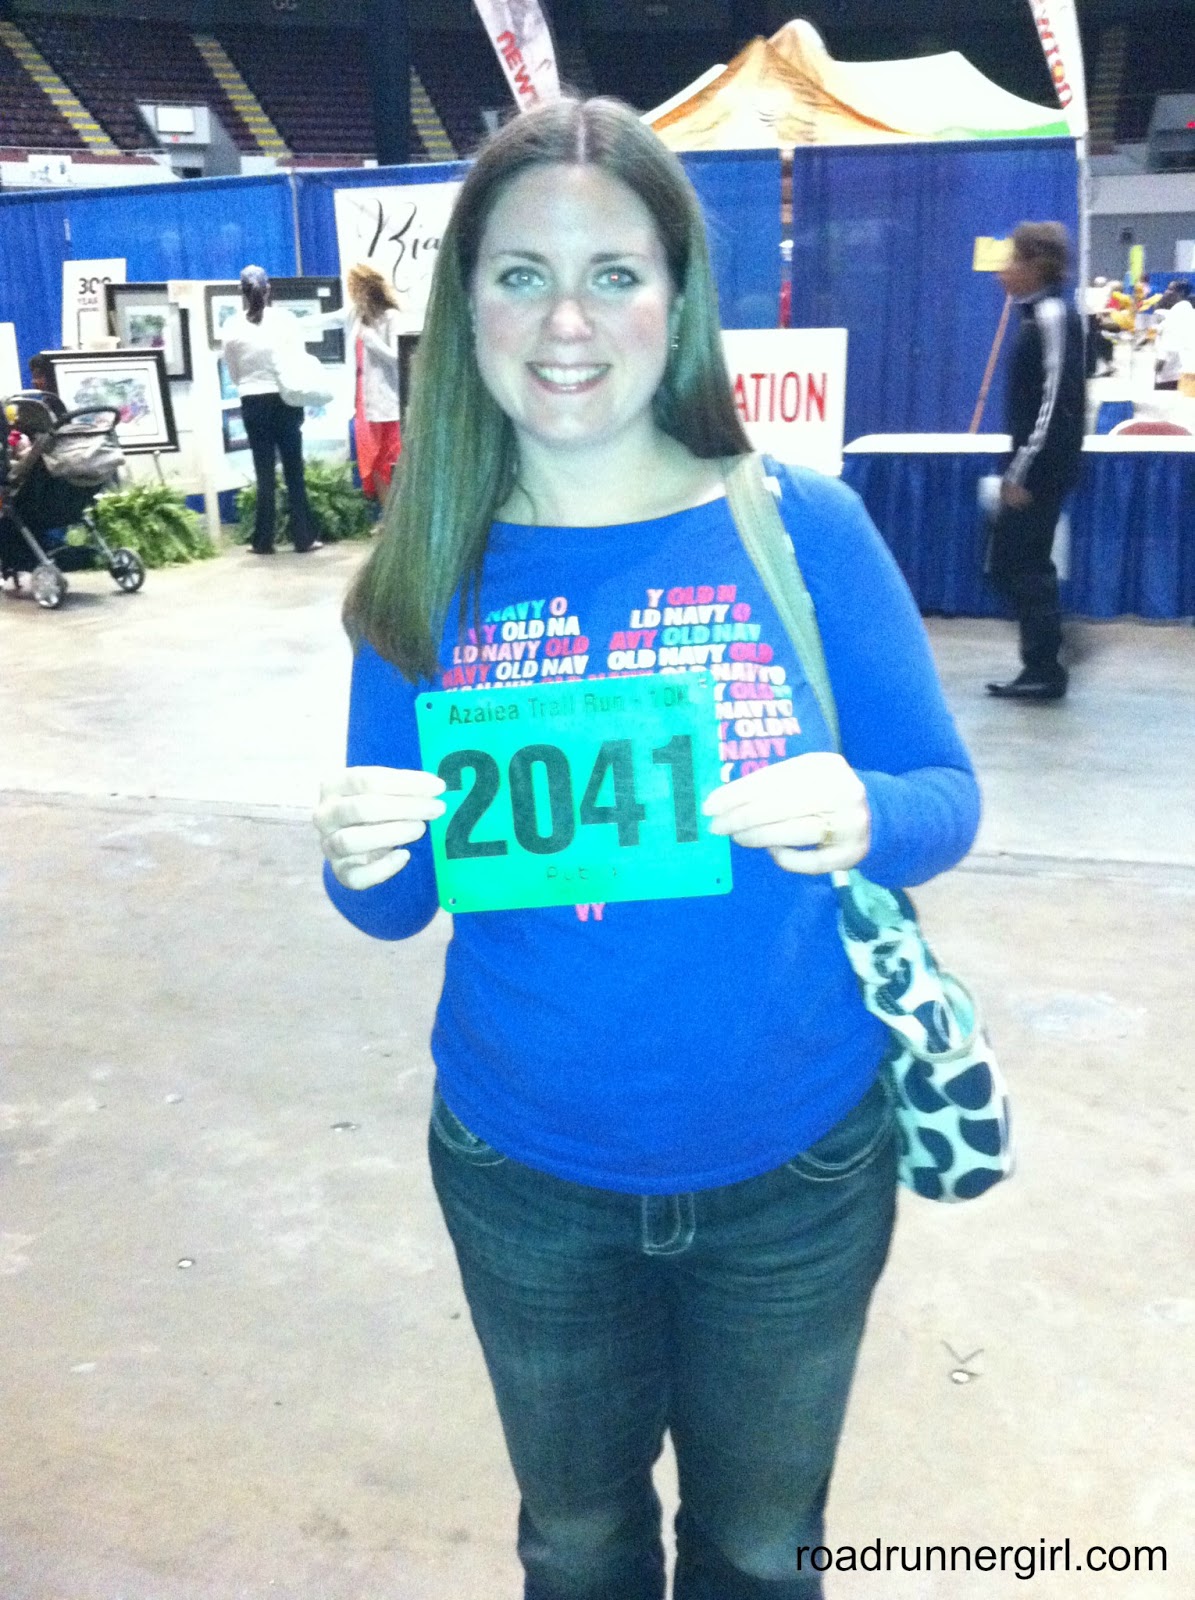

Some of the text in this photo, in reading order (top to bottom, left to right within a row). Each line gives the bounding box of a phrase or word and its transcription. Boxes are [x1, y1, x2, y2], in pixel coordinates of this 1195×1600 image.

[733, 371, 828, 423] ATION
[667, 585, 715, 606] OLD
[663, 603, 730, 626] NAVY
[501, 619, 545, 642] OLD
[546, 615, 581, 637] NA
[608, 630, 658, 651] AVY
[660, 625, 711, 646] OLD
[480, 640, 541, 662] NAVY
[545, 636, 590, 657] OLD
[606, 649, 657, 671] OLD
[658, 643, 727, 667] NAVY
[729, 642, 774, 664] OLD
[495, 660, 539, 681] OLD
[540, 655, 590, 677] NAV
[529, 695, 575, 718] Trail
[584, 691, 626, 714] Run
[719, 738, 786, 761] NAVY
[437, 734, 699, 860] 2041
